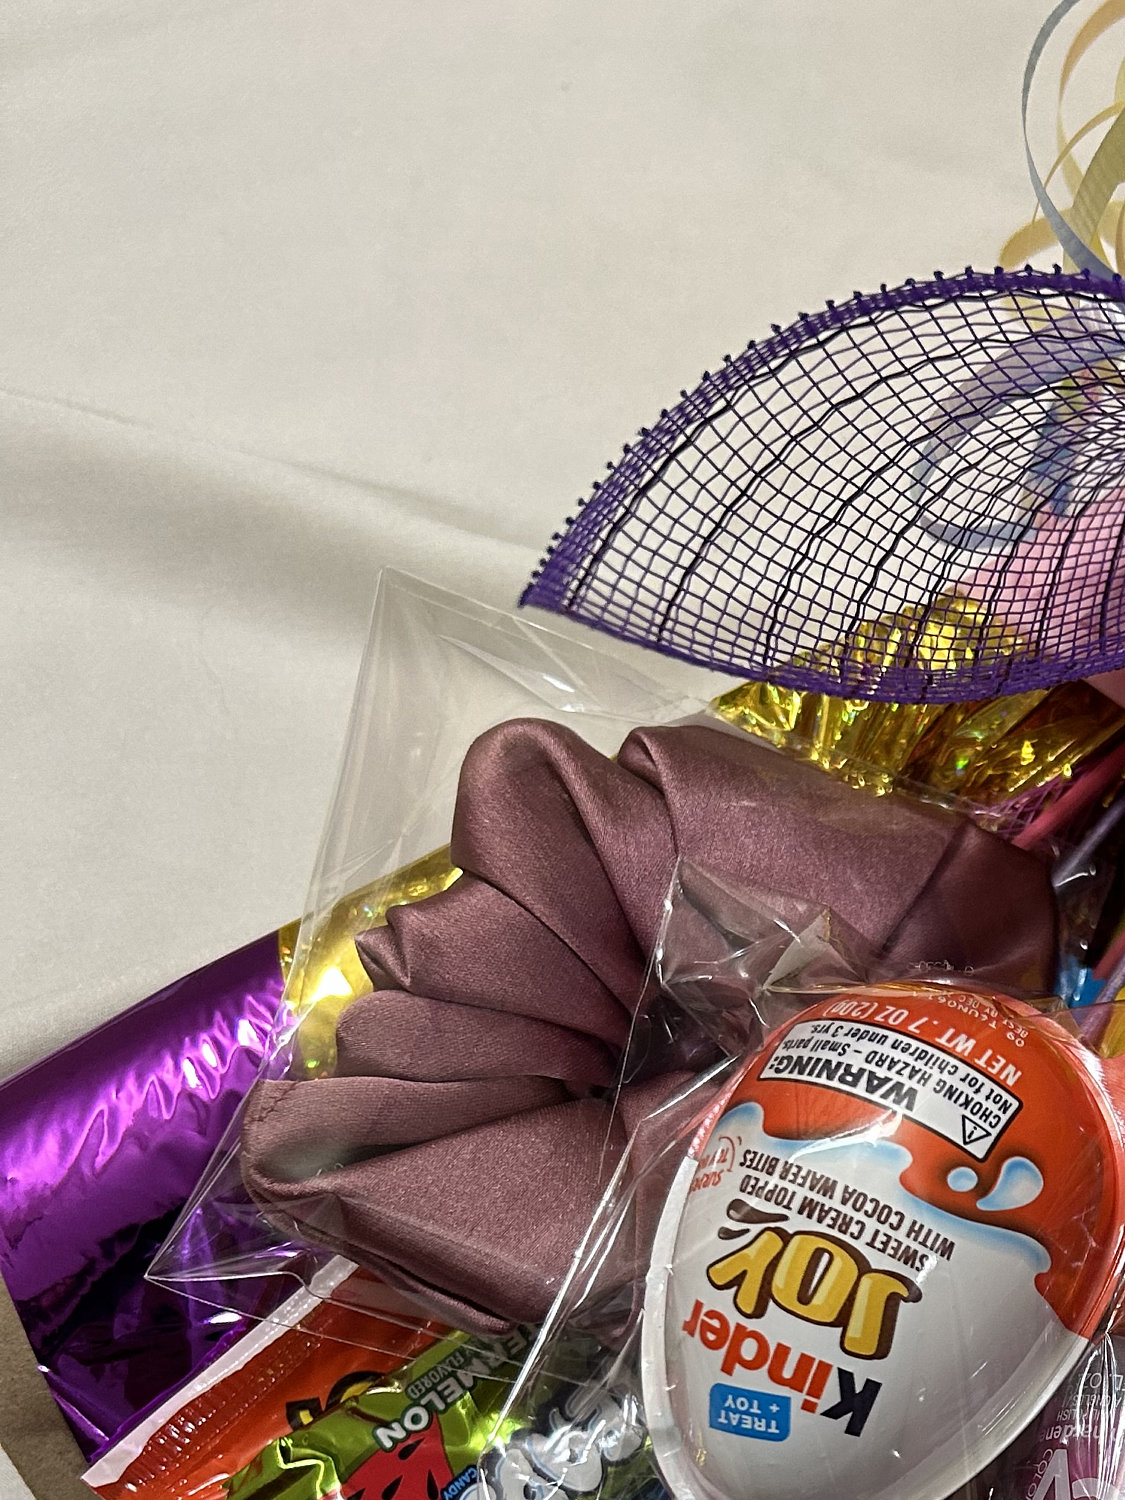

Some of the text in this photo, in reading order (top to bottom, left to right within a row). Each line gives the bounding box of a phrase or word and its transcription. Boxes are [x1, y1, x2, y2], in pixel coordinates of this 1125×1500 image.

[873, 1003, 911, 1025] OZ
[782, 1038, 812, 1052] parts.
[811, 1039, 852, 1058] Small
[935, 1031, 977, 1058] WT
[768, 1054, 919, 1113] WARNING:
[810, 1023, 1013, 1116] Not for children under 3 yrs.
[864, 1052, 935, 1093] HAZARD
[974, 1053, 1023, 1087] NET
[933, 1081, 1001, 1130] CHOKING
[738, 1149, 781, 1178] BITES
[778, 1156, 839, 1201] WAFER
[739, 1173, 930, 1273] SWEET CREAM TOPPED
[841, 1184, 906, 1233] COCOA
[905, 1218, 956, 1263] WITH
[707, 1226, 924, 1361] JOY
[682, 1299, 883, 1438] Kinder
[716, 1409, 781, 1434] TREAT
[723, 1394, 781, 1414] + TOY
